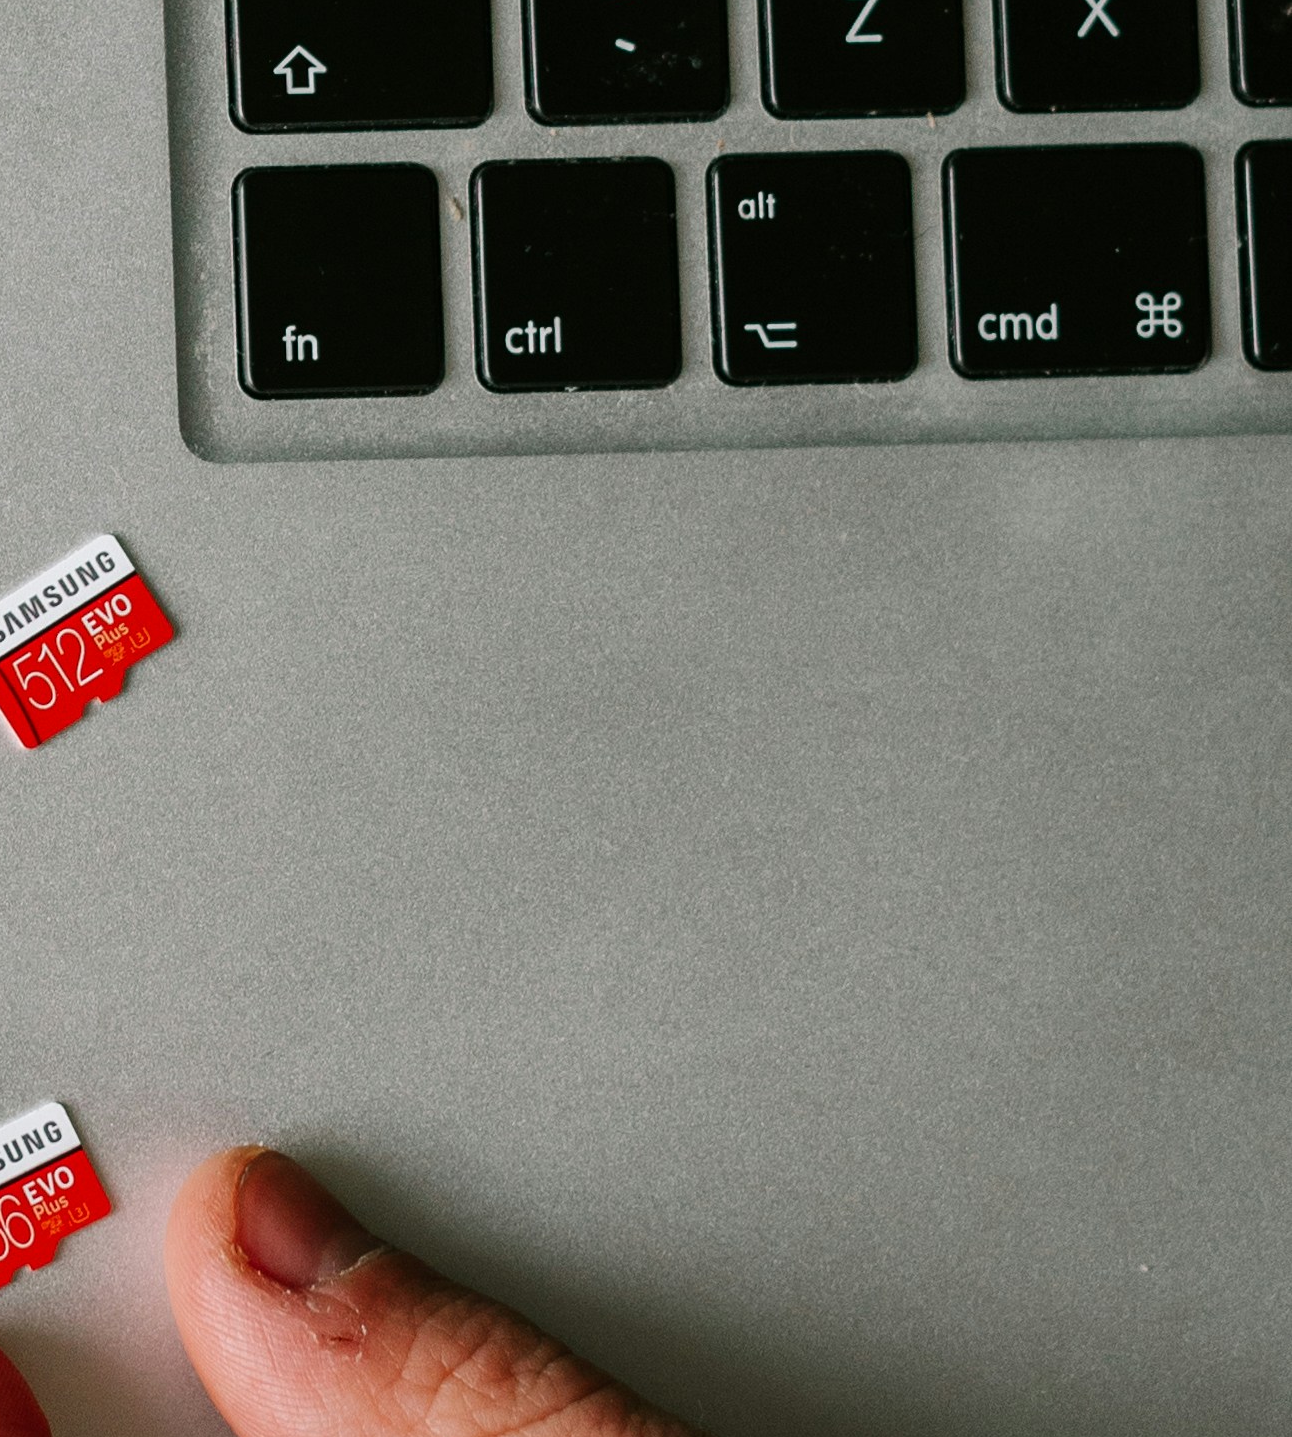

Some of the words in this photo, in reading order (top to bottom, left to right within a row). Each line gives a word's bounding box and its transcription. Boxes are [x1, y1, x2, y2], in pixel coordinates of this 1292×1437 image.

[737, 190, 776, 220] alt
[504, 315, 562, 355] ctrl
[977, 302, 1059, 341] cmd
[281, 324, 319, 362] fn
[11, 627, 104, 711] 512
[81, 593, 133, 637] EVO
[93, 623, 129, 651] Plus
[23, 1166, 74, 1207] EVO
[32, 1195, 69, 1222] Plus
